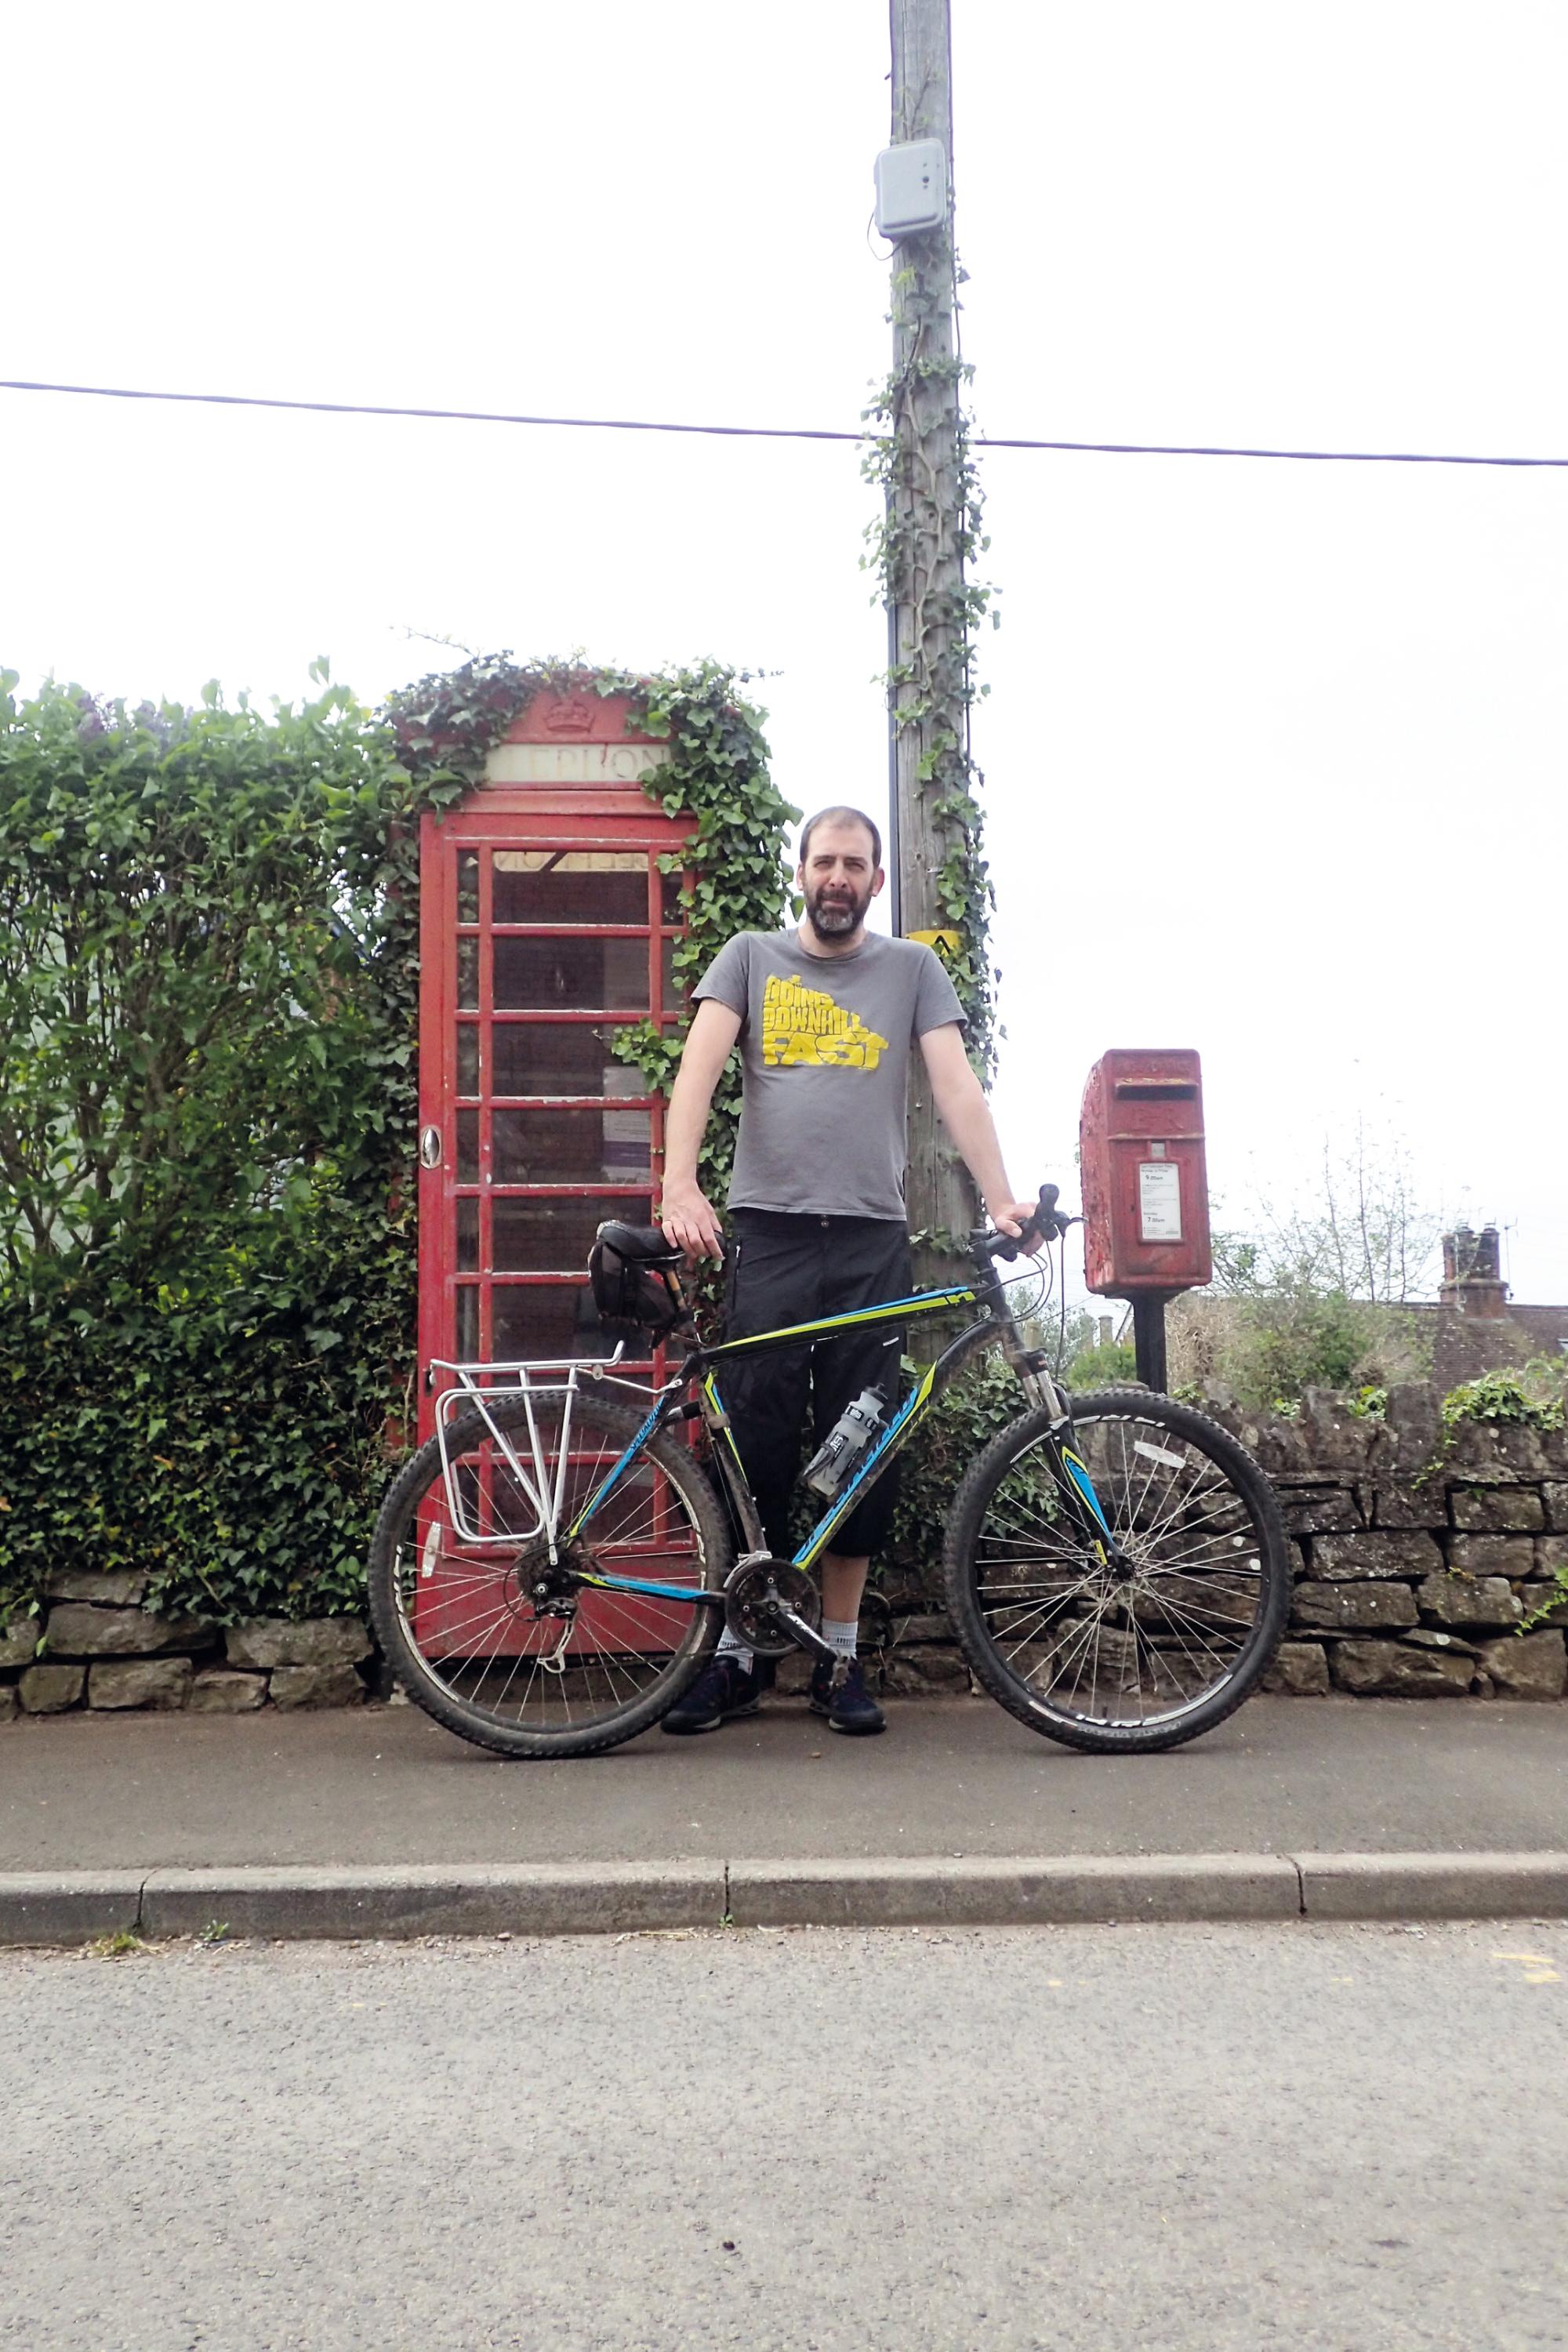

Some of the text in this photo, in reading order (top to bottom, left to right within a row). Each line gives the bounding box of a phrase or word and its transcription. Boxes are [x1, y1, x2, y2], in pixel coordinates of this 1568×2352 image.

[763, 975, 834, 1009] GOING
[763, 1006, 869, 1034] DOWNHILL
[763, 1031, 889, 1070] FAST
